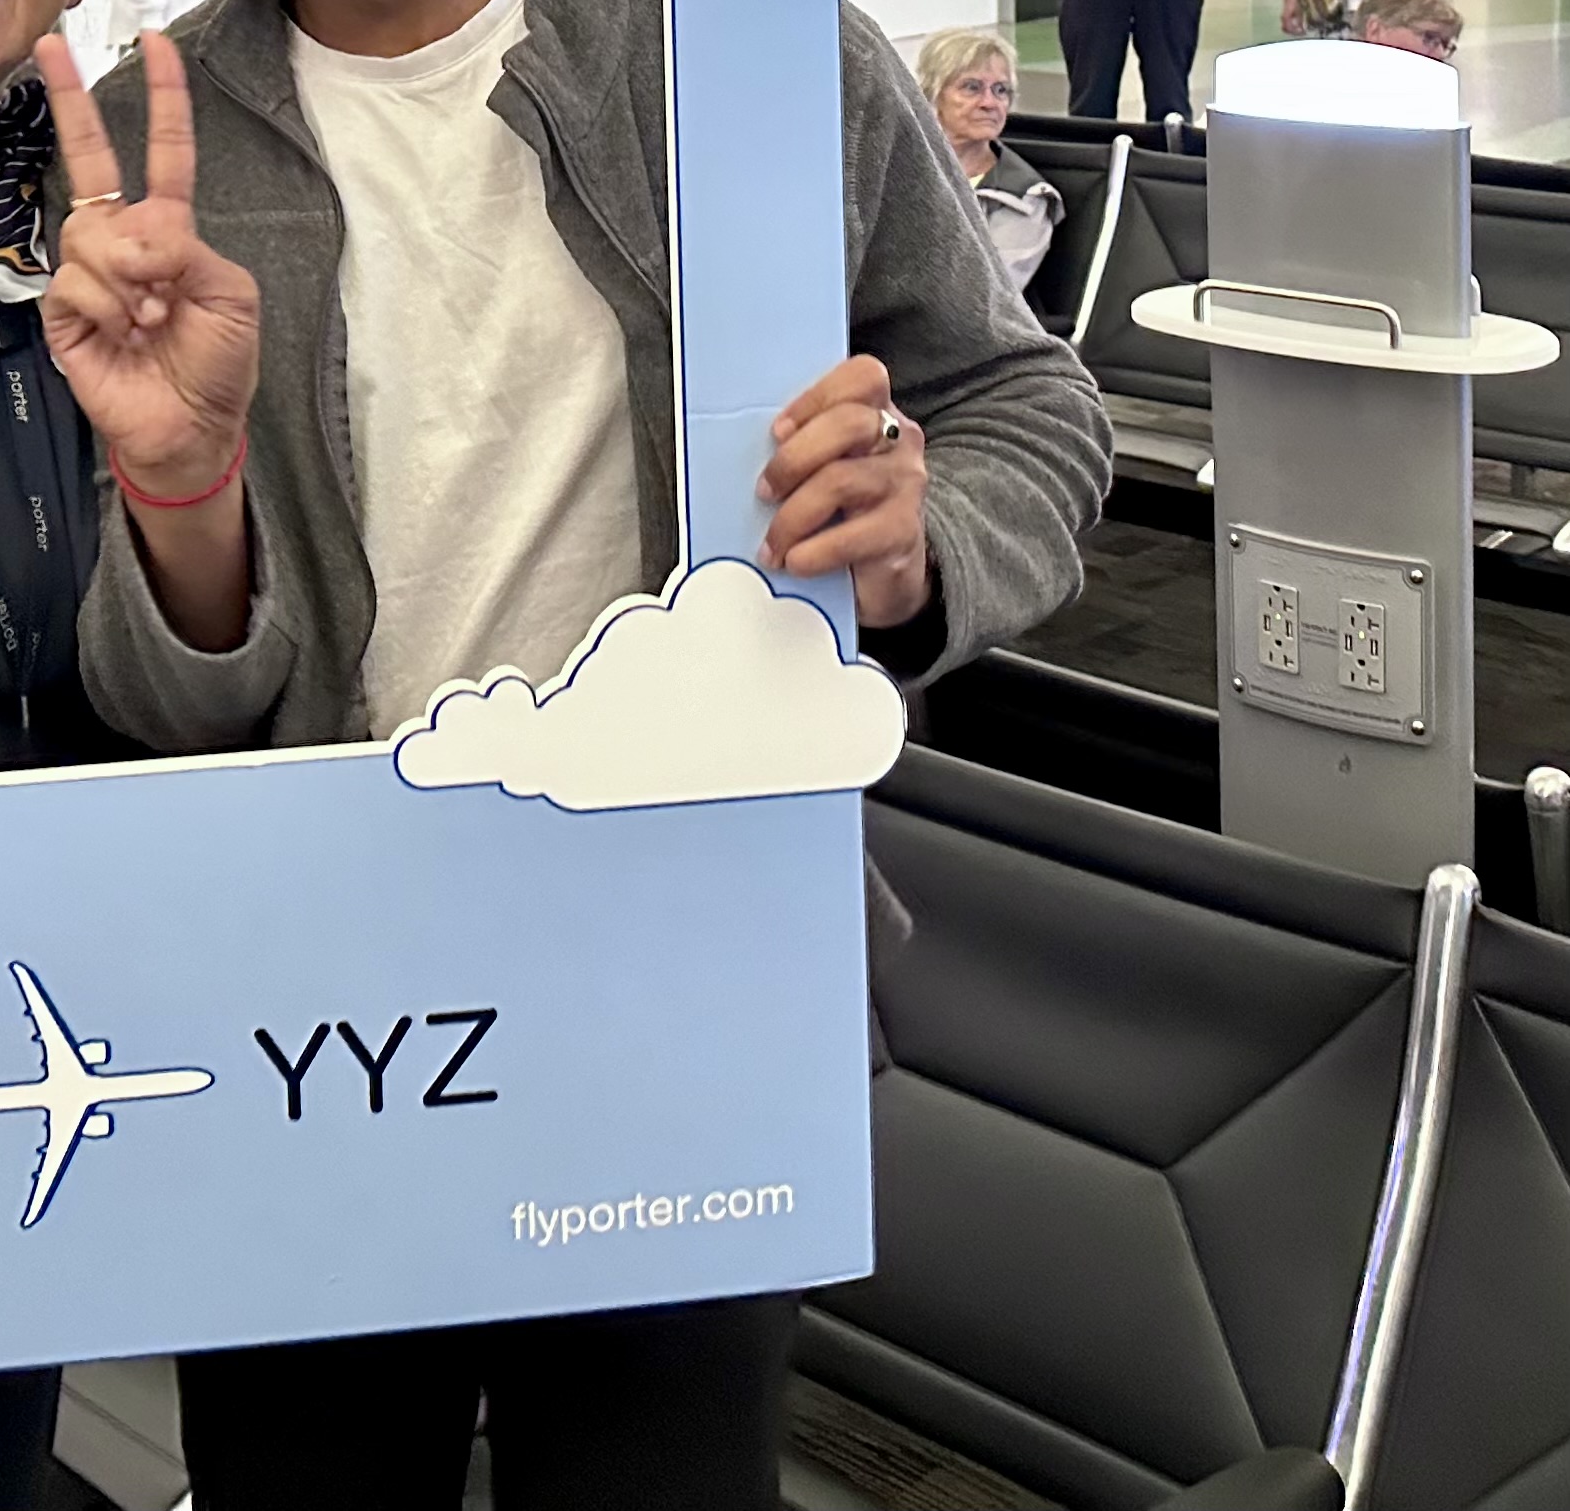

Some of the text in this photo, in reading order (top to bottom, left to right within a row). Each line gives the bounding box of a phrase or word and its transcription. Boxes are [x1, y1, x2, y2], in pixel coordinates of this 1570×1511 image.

[7, 369, 31, 424] porter
[30, 494, 49, 553] porter
[253, 1007, 499, 1121] YYZ
[511, 1184, 794, 1247] flyporter.com
